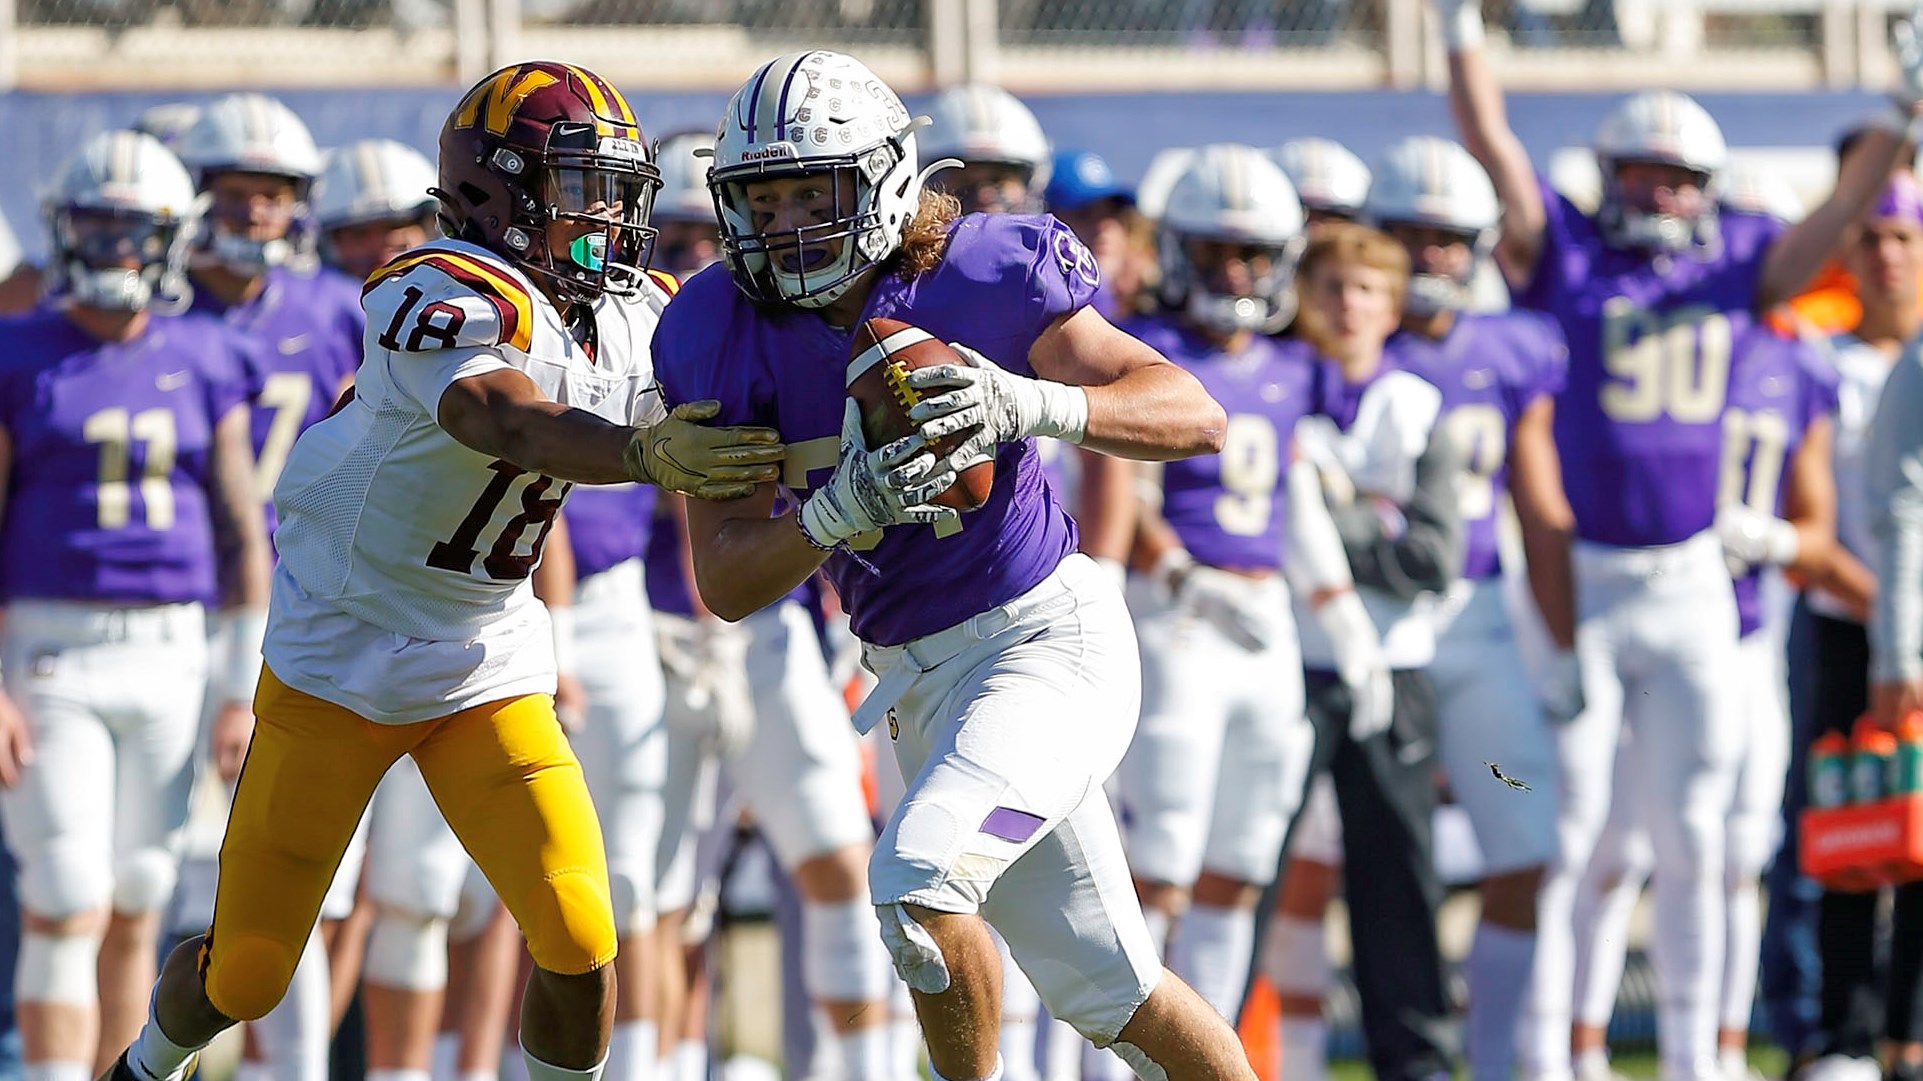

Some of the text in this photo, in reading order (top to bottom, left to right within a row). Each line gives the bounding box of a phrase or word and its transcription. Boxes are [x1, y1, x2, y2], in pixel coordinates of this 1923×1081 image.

[454, 65, 560, 138] N
[378, 285, 466, 352] 18
[1600, 297, 1731, 424] 90
[84, 406, 177, 531] 11
[425, 458, 573, 580] 18
[1213, 411, 1279, 537] 9
